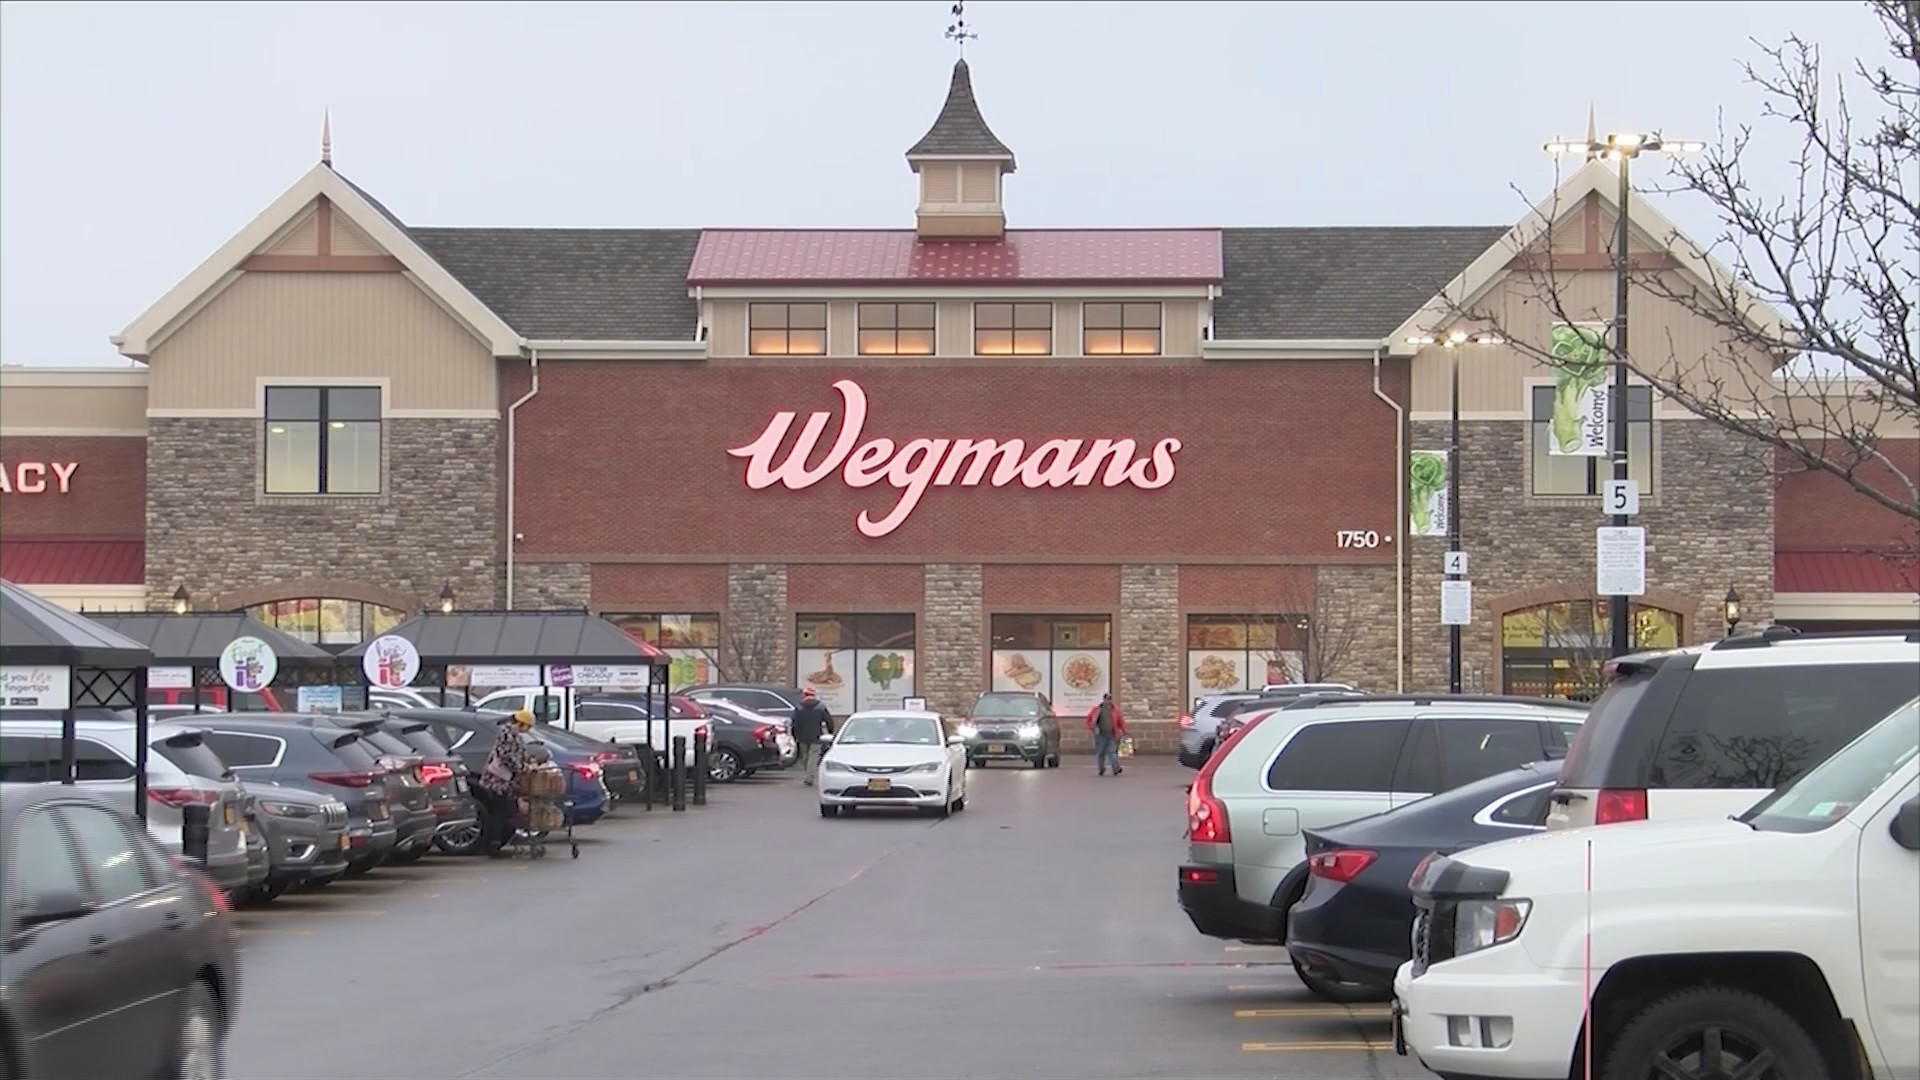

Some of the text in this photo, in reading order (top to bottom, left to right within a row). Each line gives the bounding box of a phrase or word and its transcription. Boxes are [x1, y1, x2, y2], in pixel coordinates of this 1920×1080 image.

[1586, 388, 1606, 448] Welcome
[727, 379, 1182, 537] Wegmans
[1614, 485, 1627, 509] 5
[1433, 492, 1446, 530] Welcome
[1336, 530, 1380, 548] 1750
[1451, 555, 1461, 570] 4
[5, 683, 50, 694] fingertips
[10, 673, 28, 683] you
